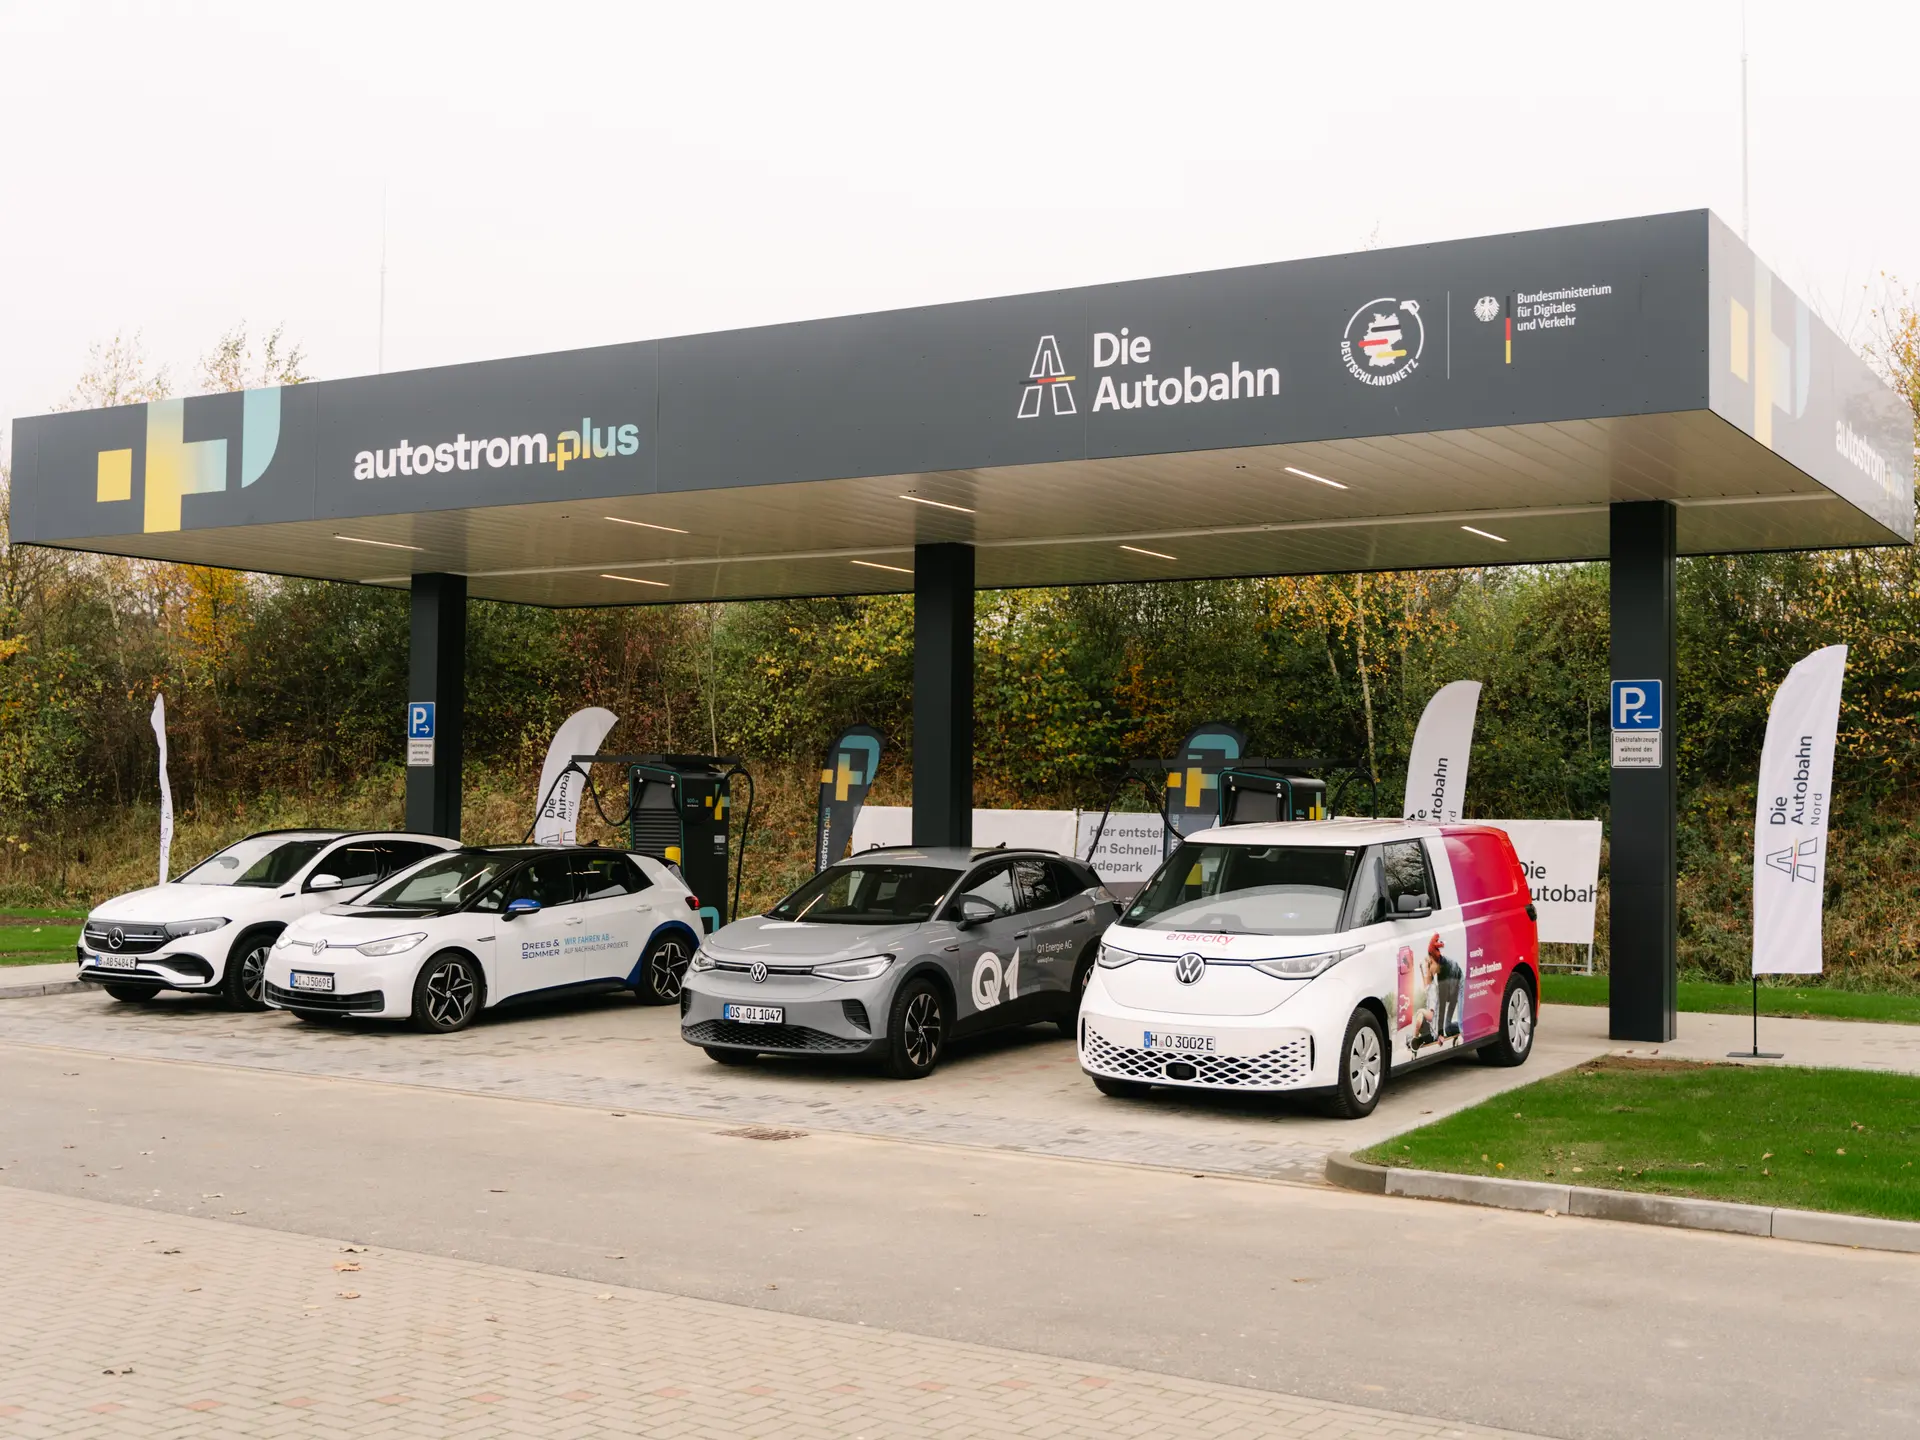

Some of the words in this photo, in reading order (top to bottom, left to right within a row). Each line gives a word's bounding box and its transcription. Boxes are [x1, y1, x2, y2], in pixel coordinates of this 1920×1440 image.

[1517, 284, 1612, 304] Bundesministerium
[1517, 305, 1532, 317] für
[1533, 302, 1576, 317] Digitales
[1517, 320, 1536, 331] und
[1538, 315, 1577, 328] Verkehr
[1093, 327, 1151, 368] Die
[1340, 341, 1419, 386] DEUTSCHLANDNETZ
[1092, 361, 1280, 412] Autobahn
[353, 417, 640, 481] autostrom.plus
[1620, 687, 1646, 724] P
[412, 707, 427, 734] P
[1431, 757, 1449, 822] utobahn
[1791, 735, 1812, 825] Autobahn
[556, 771, 571, 820] Autoba
[544, 797, 558, 819] Die
[1770, 796, 1788, 825] Die
[1811, 793, 1822, 825] Nord
[820, 807, 831, 872] tostrom.plus
[1089, 825, 1116, 837] Her
[1110, 843, 1163, 855] Schnell-
[1091, 860, 1143, 873] adepark
[1530, 884, 1598, 903] utobah
[553, 938, 560, 947] &
[564, 937, 577, 946] WIR
[578, 934, 600, 944] FAHREN
[601, 933, 610, 941] AB
[574, 943, 606, 953] NACHHALTIGE
[607, 941, 629, 950] PROJEKTE
[1045, 941, 1064, 953] Energie
[1064, 939, 1072, 949] AG
[1166, 933, 1235, 946] enercity
[521, 948, 560, 960] SOMMER
[971, 946, 1020, 1012] Q1
[729, 1006, 740, 1018] OS
[759, 1008, 781, 1021] 1047
[1150, 1034, 1158, 1046] H
